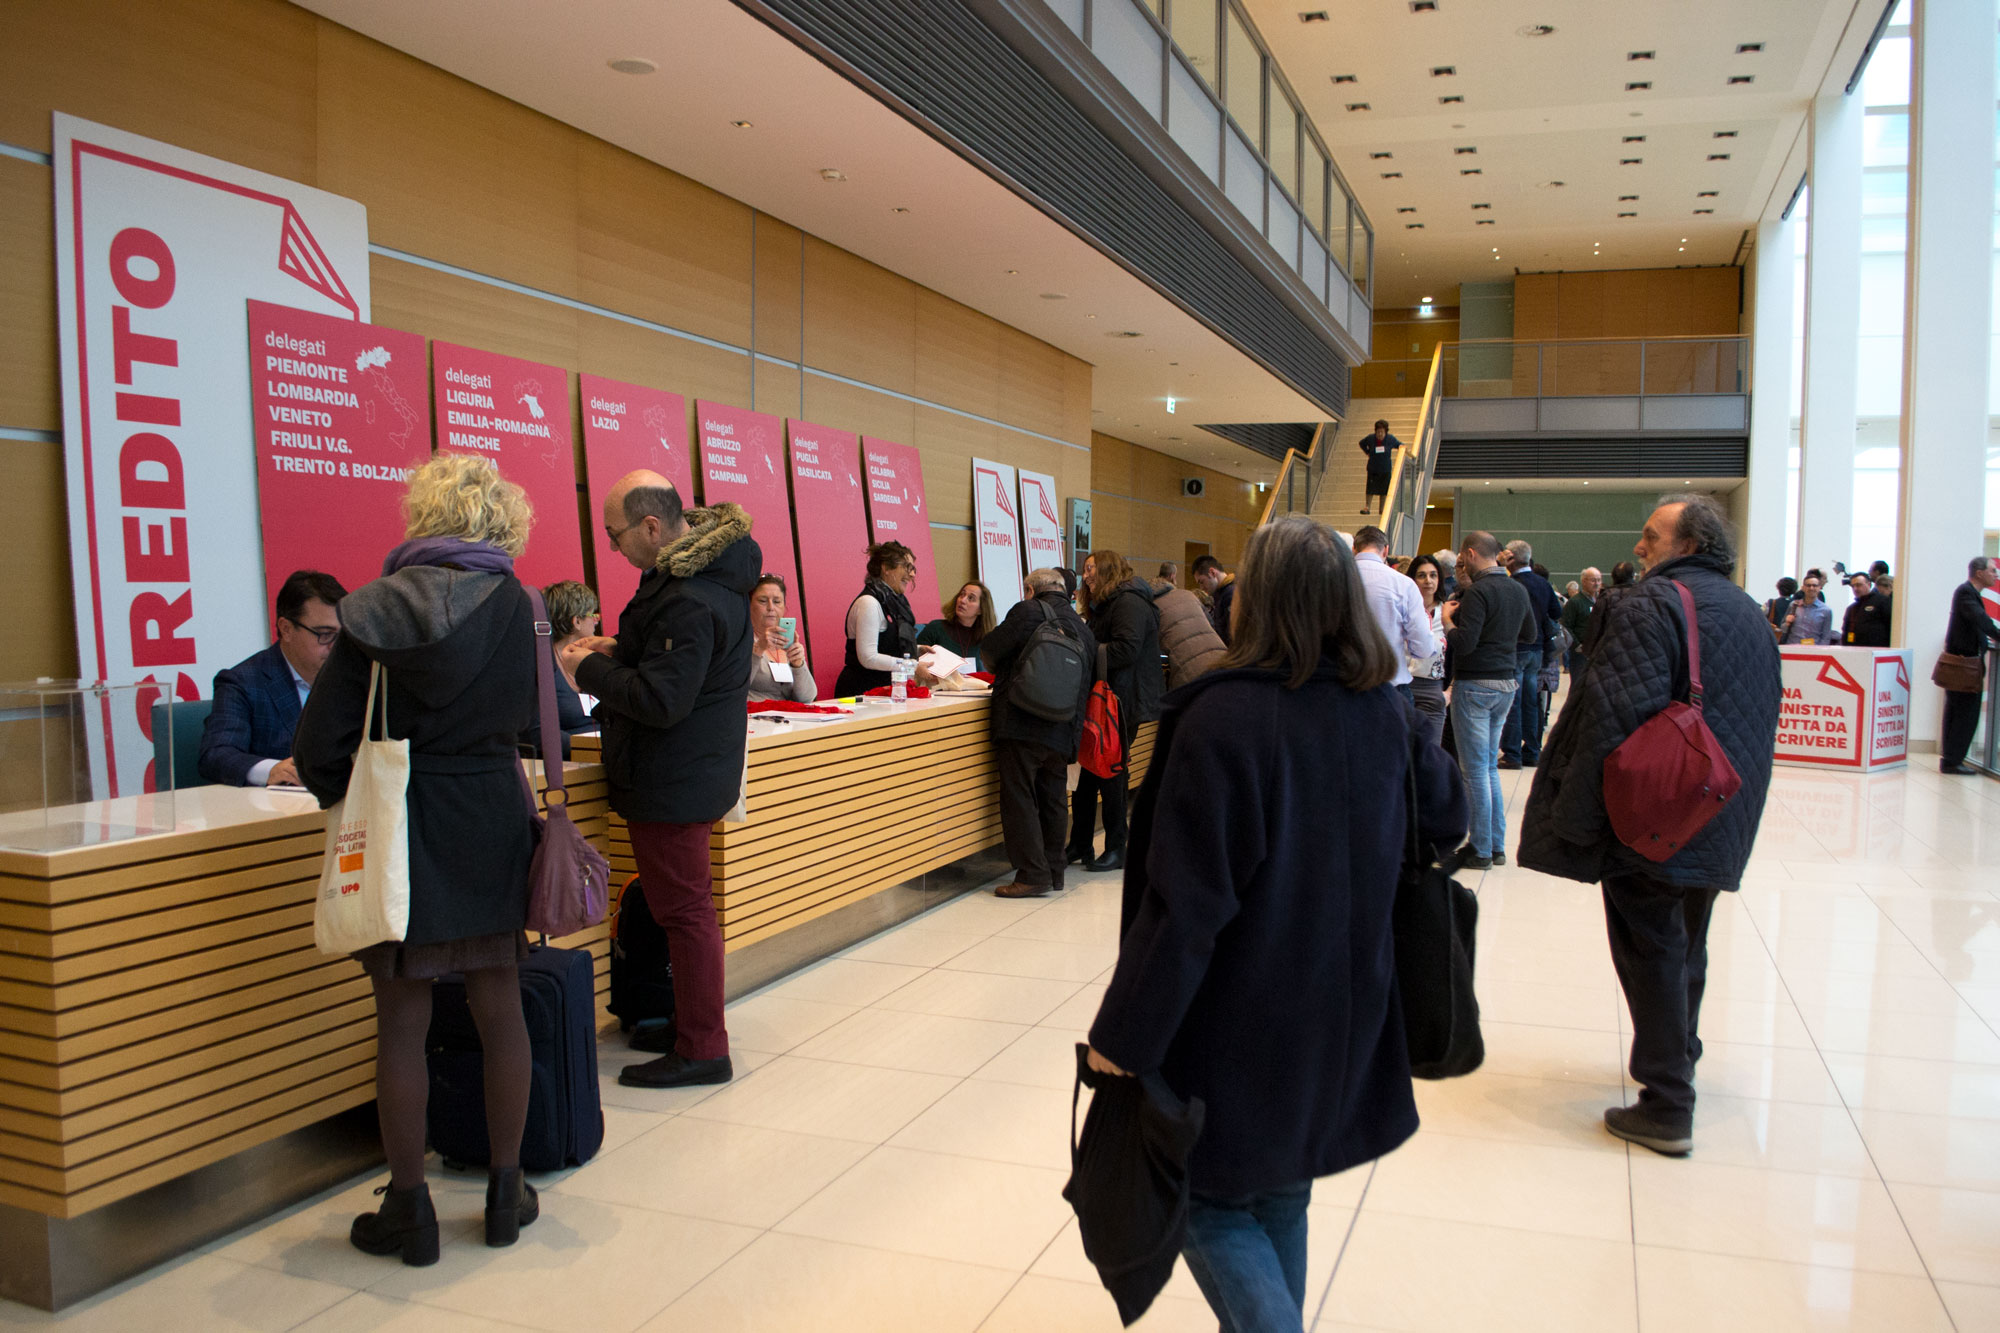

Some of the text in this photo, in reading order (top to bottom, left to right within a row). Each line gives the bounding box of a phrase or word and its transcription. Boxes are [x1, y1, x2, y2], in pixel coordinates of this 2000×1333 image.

[265, 330, 326, 357] delegati
[266, 355, 348, 384] PIEMONTE
[445, 367, 492, 390] delegati
[267, 380, 359, 409] LOMBARDIA
[446, 388, 495, 410] LIGURIA
[590, 396, 627, 416] delegati
[268, 405, 332, 428] VENETO
[447, 410, 551, 439] EMILIA-ROMAGNA
[591, 415, 620, 431] LAZIO
[705, 419, 734, 436] delegati
[270, 430, 353, 454] FRIULI V.G.
[449, 431, 501, 451] MARCHE
[706, 436, 741, 452] ABRUZZO
[794, 436, 819, 451] delegati
[272, 455, 336, 475] TRENTO
[339, 462, 350, 477] &
[707, 452, 737, 467] MOLISE
[795, 451, 819, 465] PUGLIA
[868, 452, 889, 465] delegati
[709, 469, 749, 485] CAMPANIA
[797, 466, 832, 481] BASILICATA
[869, 465, 896, 479] CALABRIA
[871, 479, 891, 491] SICILIA
[873, 492, 902, 505] SARDEGNA
[109, 227, 201, 793] CREDITO
[1085, 510, 1090, 524] 2
[876, 519, 898, 530] ESTERO
[983, 531, 1013, 548] STAMPA
[1030, 537, 1057, 552] INVITATI
[1781, 687, 1802, 700] NA
[1878, 691, 1891, 702] UNA
[1779, 702, 1845, 718] INISTRA
[1877, 704, 1904, 718] SINISTRA
[1777, 717, 1847, 733] UTTA DA
[1877, 720, 1904, 734] TUTTA DA
[1774, 732, 1847, 749] CRIVERE
[1875, 734, 1904, 749] SCRIVERE
